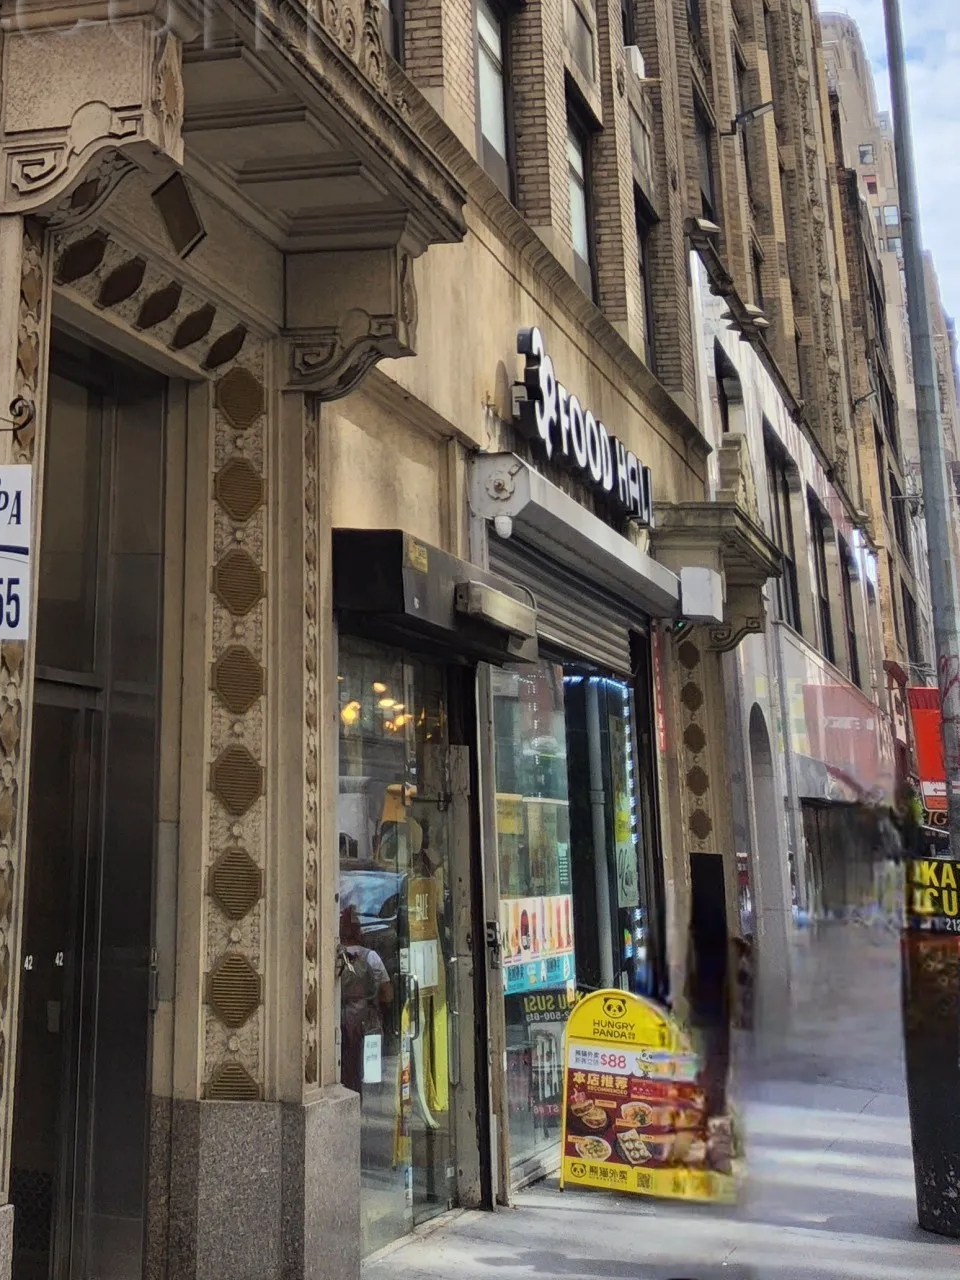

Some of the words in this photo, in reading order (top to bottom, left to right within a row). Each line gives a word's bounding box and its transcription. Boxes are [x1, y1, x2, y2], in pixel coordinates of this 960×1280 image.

[557, 384, 613, 492] FOOD
[24, 955, 33, 970] 42
[55, 951, 64, 966] 42
[593, 1019, 635, 1031] HUNGRY
[593, 1028, 627, 1040] PANDA
[600, 1053, 626, 1069] $88
[573, 1071, 628, 1090] 本店推荐
